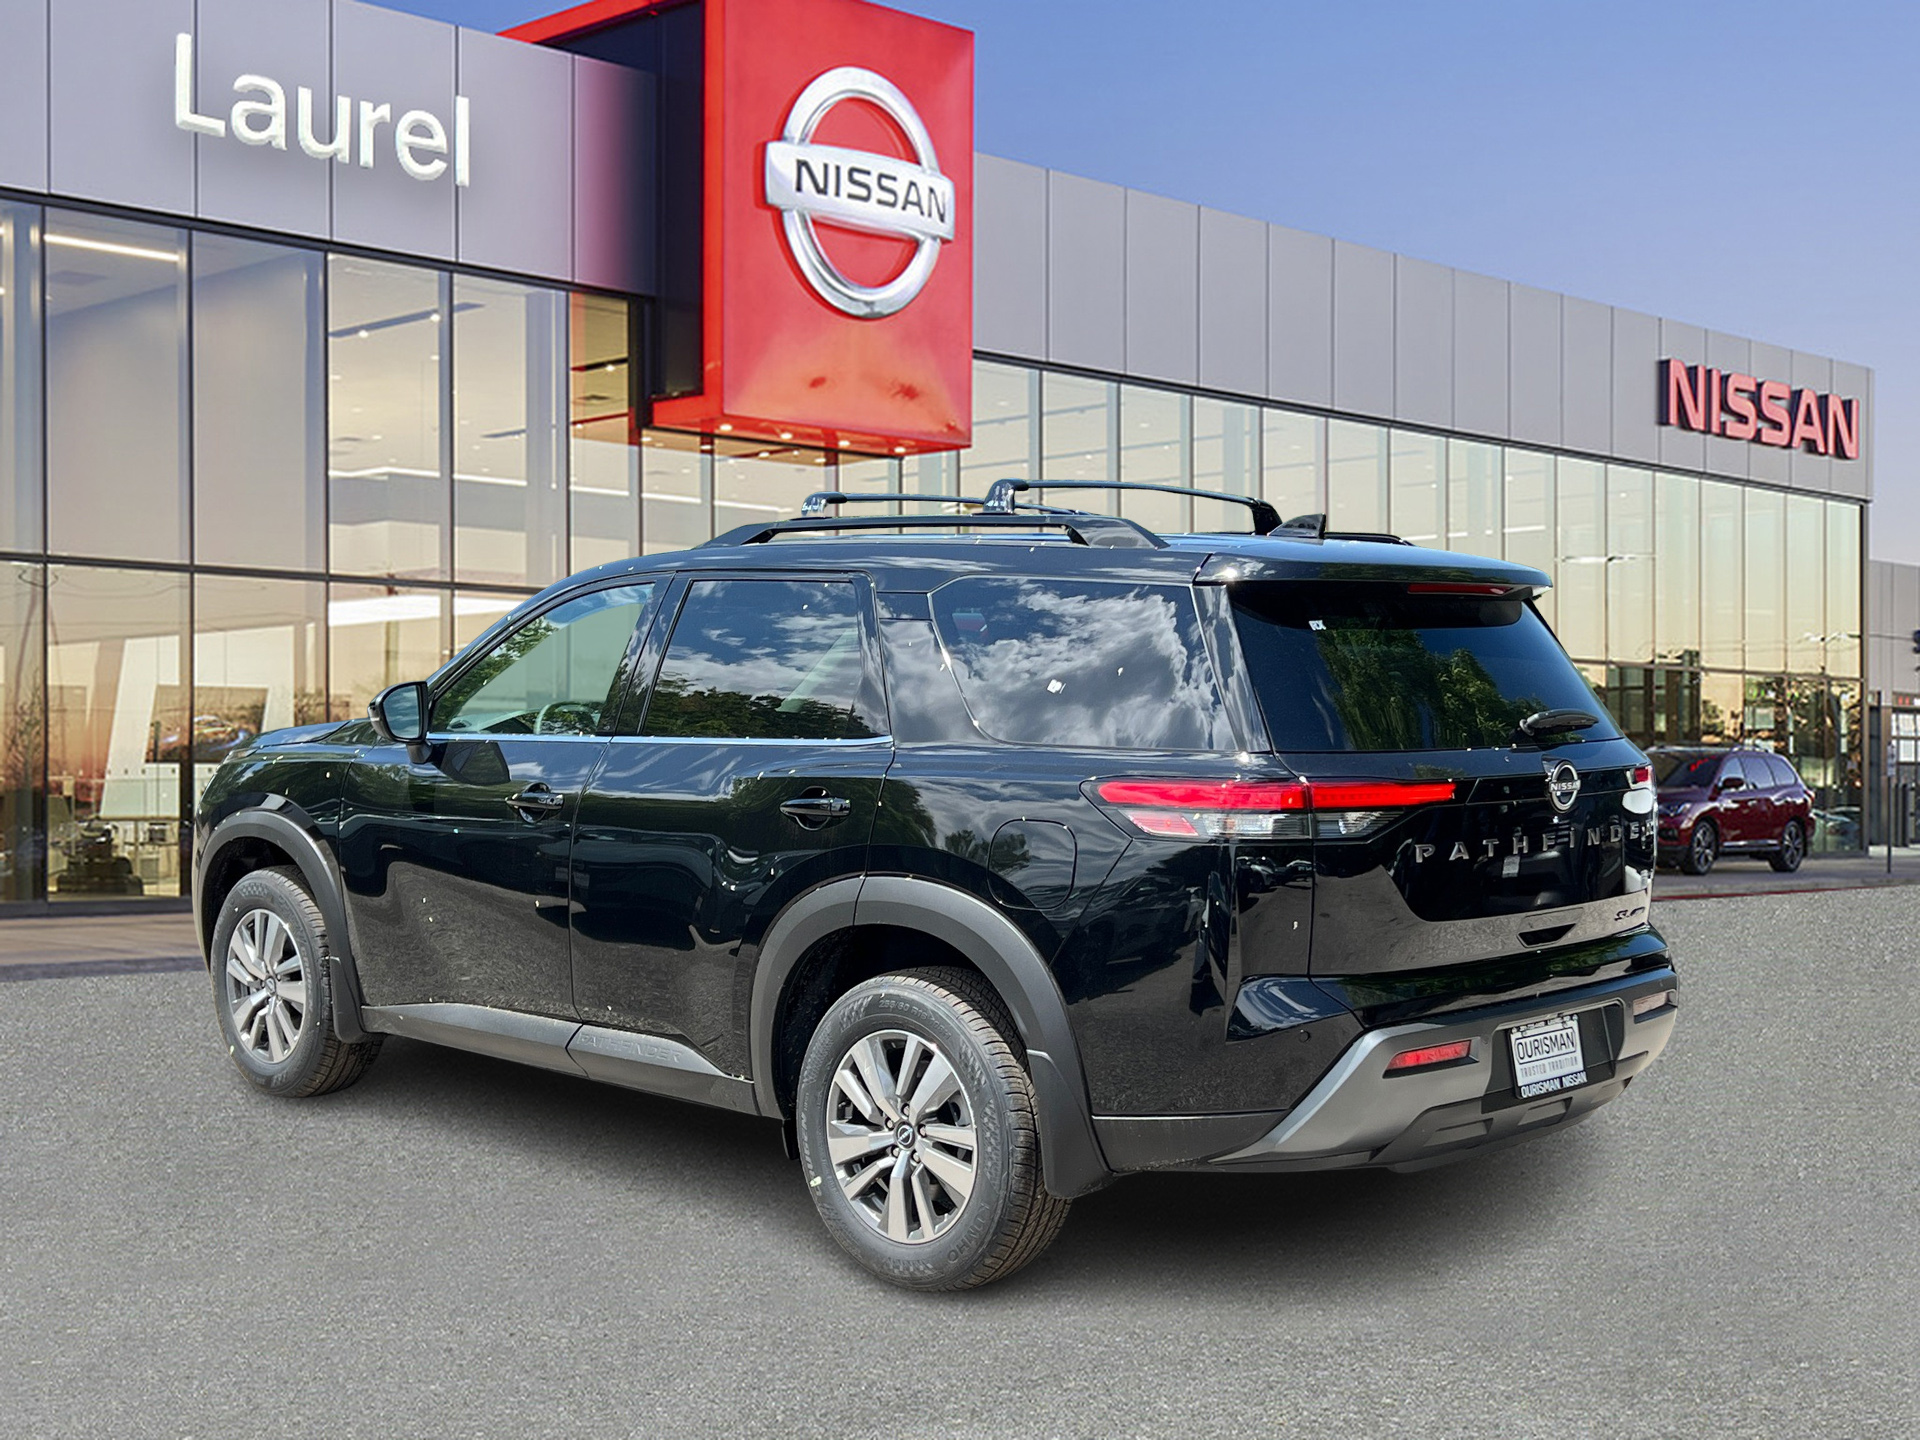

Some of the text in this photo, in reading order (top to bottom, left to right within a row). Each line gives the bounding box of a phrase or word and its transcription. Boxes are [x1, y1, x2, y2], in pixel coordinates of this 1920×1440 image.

[174, 32, 470, 188] Laurel
[795, 158, 949, 225] NISSAN
[1658, 358, 1860, 459] NISSAN
[1516, 1031, 1575, 1060] OURISMAN
[1521, 1071, 1588, 1099] OURISMAN NISSAN
